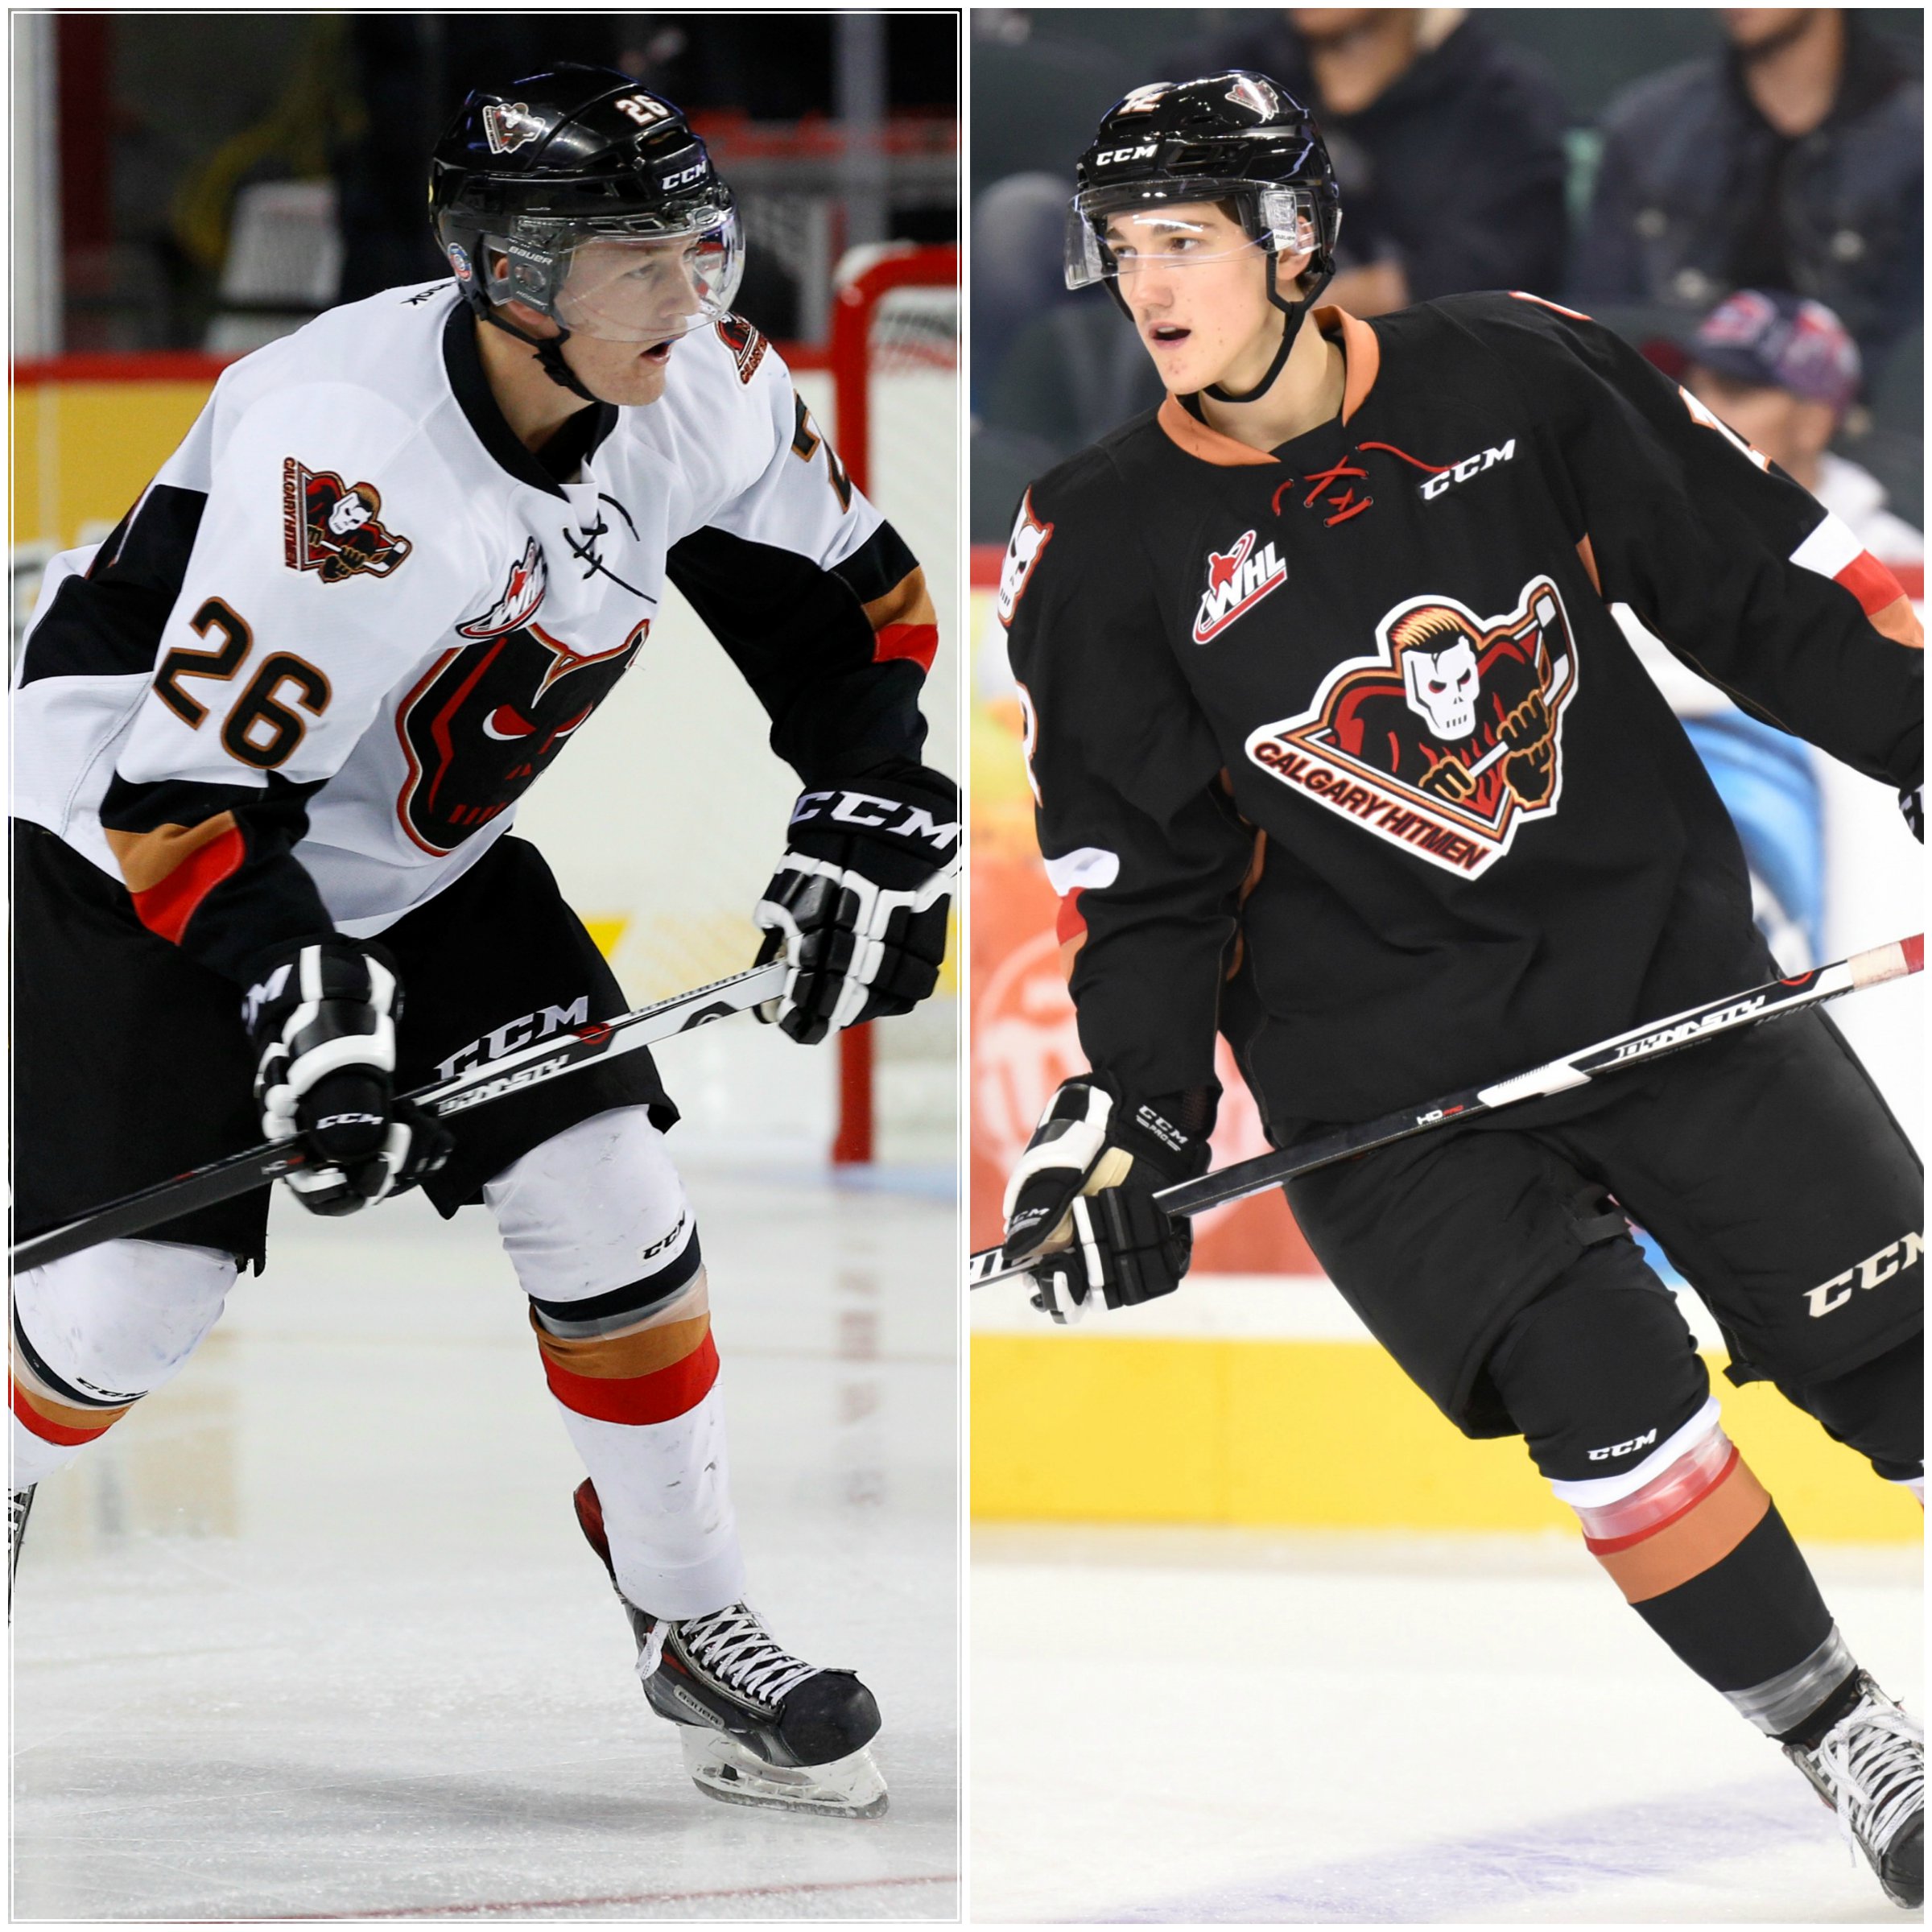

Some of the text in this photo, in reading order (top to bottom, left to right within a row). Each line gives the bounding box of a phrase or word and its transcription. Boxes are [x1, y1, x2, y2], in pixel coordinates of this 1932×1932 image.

[614, 94, 670, 126] 26
[662, 160, 707, 190] CCM
[1096, 144, 1158, 166] CCM
[1420, 439, 1515, 500] CCM
[283, 456, 299, 569] CALGARY HITMEN
[1202, 541, 1286, 622] WHL
[151, 596, 332, 770] 26
[790, 791, 962, 850] CCM
[1253, 741, 1492, 872] CALGARY HITMEN
[435, 995, 588, 1080] CCM
[1615, 995, 1766, 1059] DYNASTY
[316, 1113, 384, 1129] CCM
[1139, 1104, 1188, 1144] CCM
[1586, 1428, 1657, 1461] CCM
